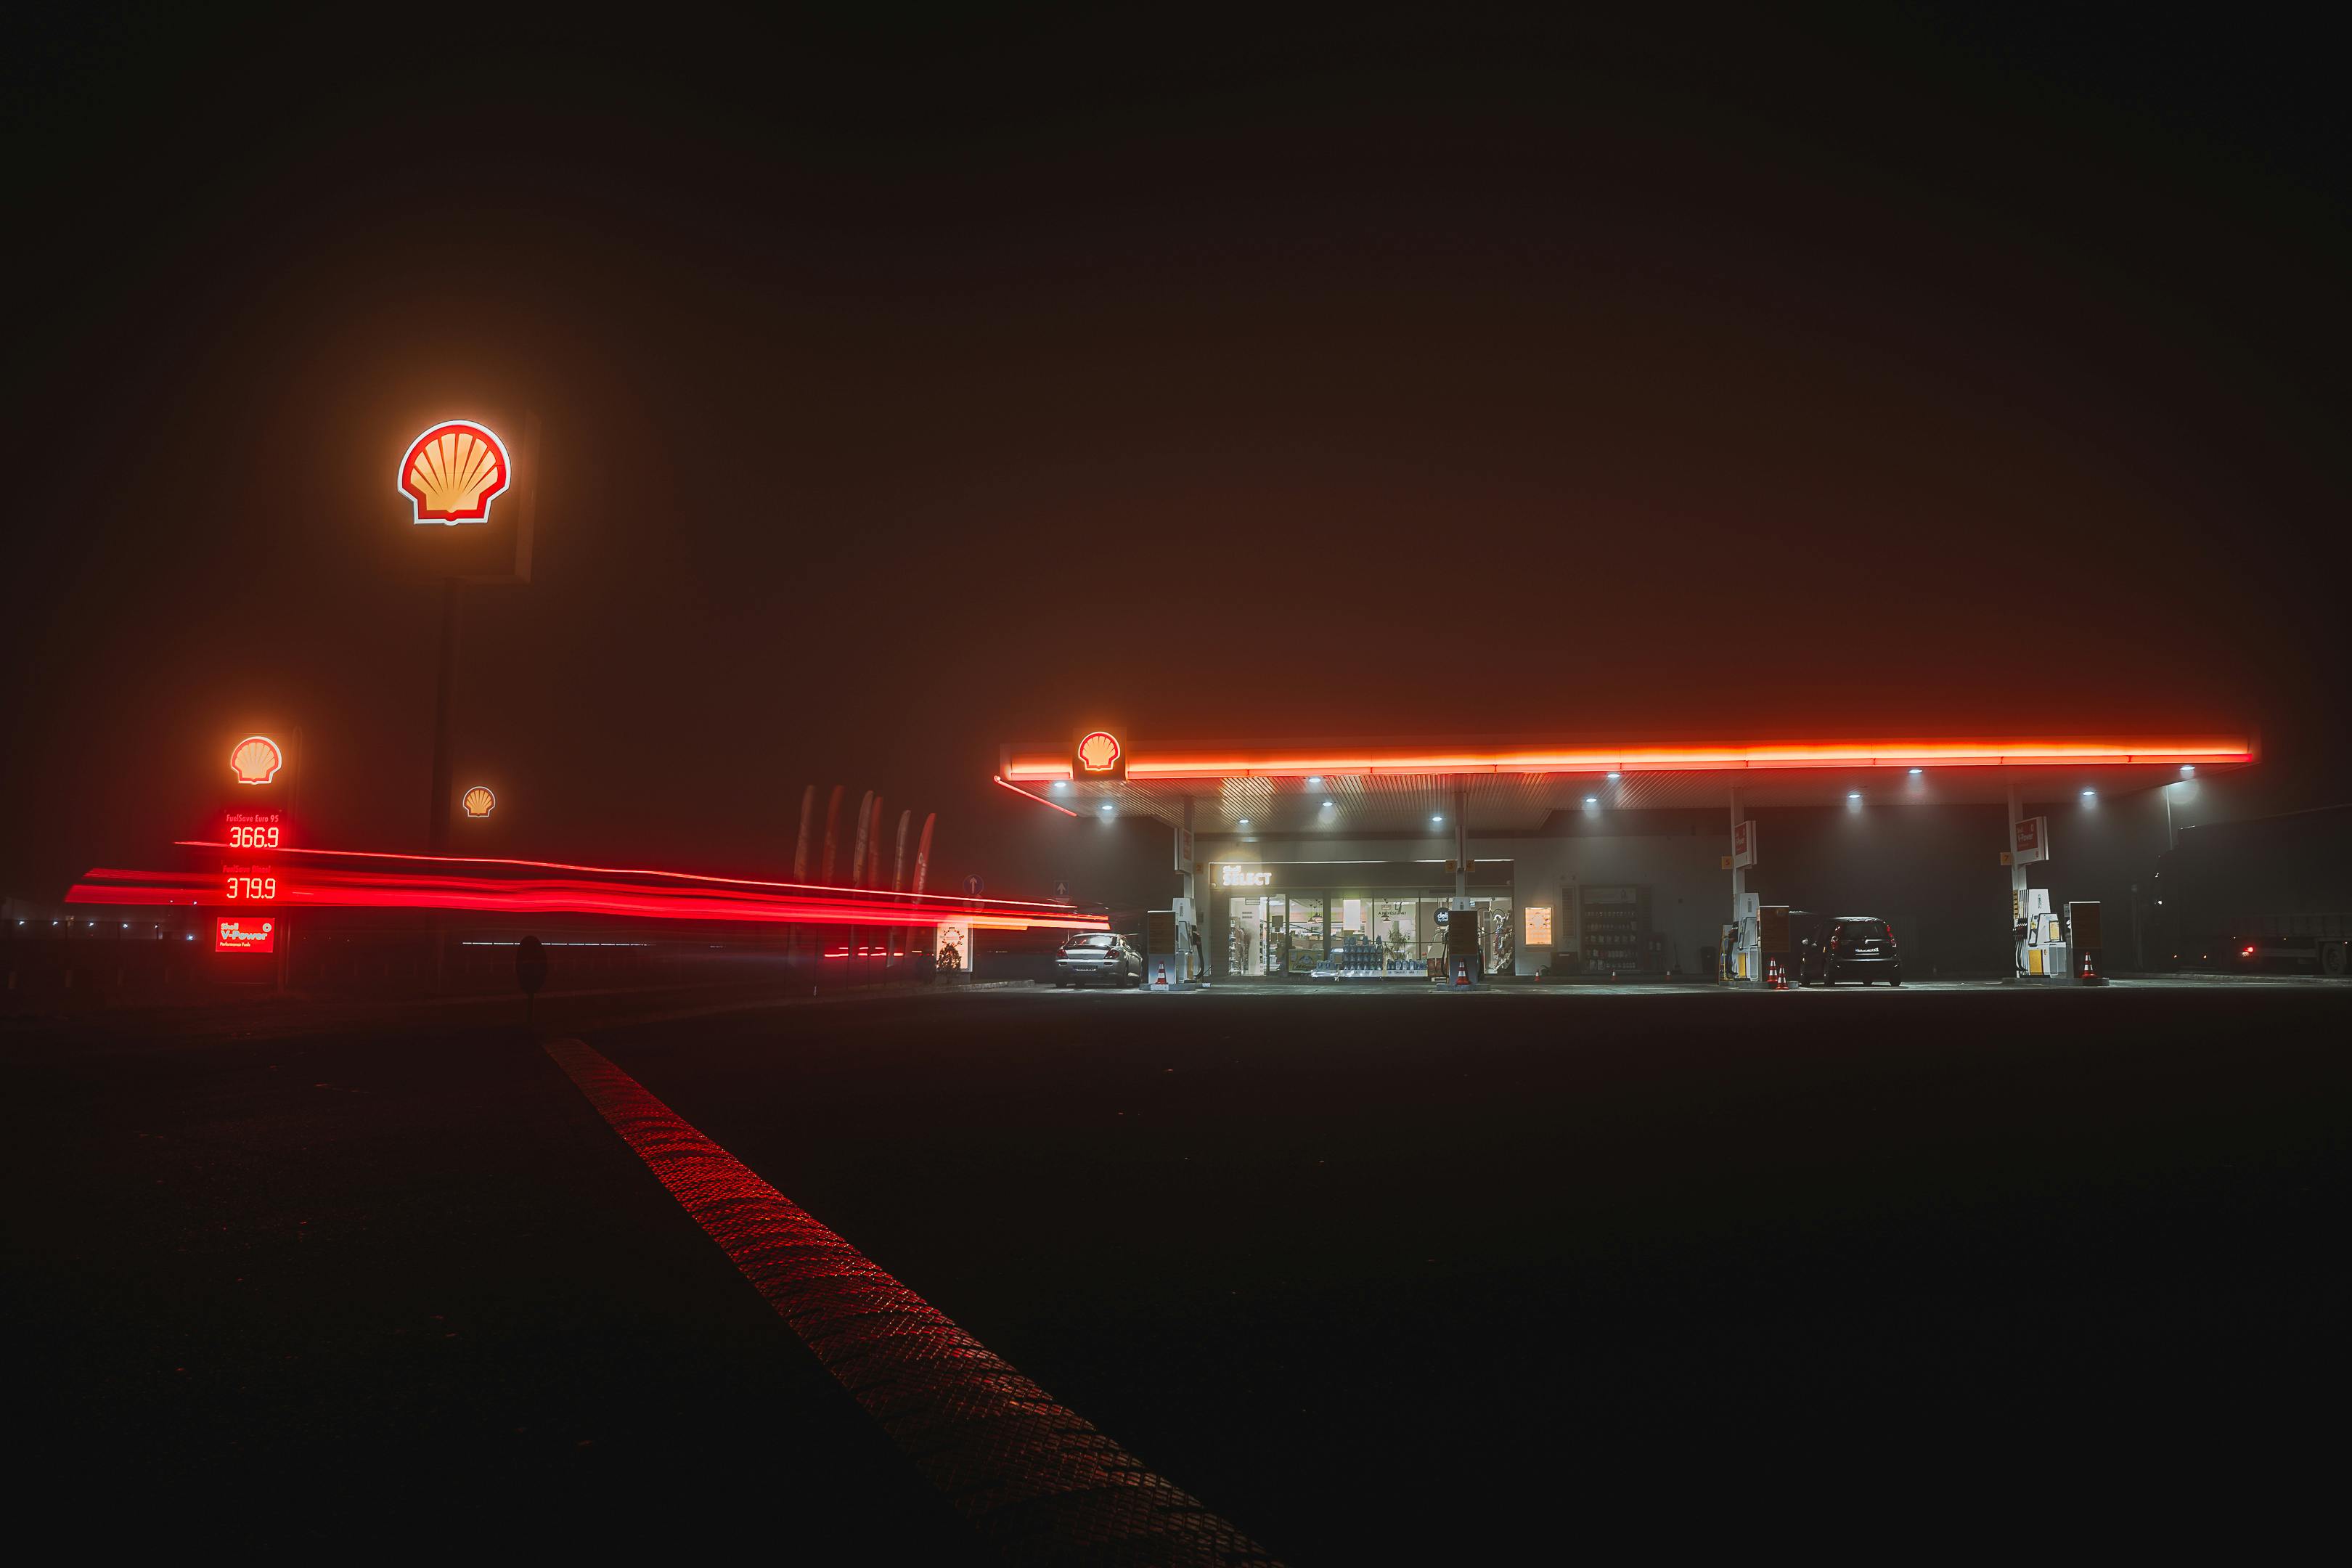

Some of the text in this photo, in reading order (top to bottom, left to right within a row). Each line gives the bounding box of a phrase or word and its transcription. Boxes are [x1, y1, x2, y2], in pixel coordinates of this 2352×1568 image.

[229, 826, 279, 848] 366.9
[1222, 873, 1272, 886] SELECT
[226, 878, 276, 899] 379.9
[221, 930, 268, 940] V-Power
